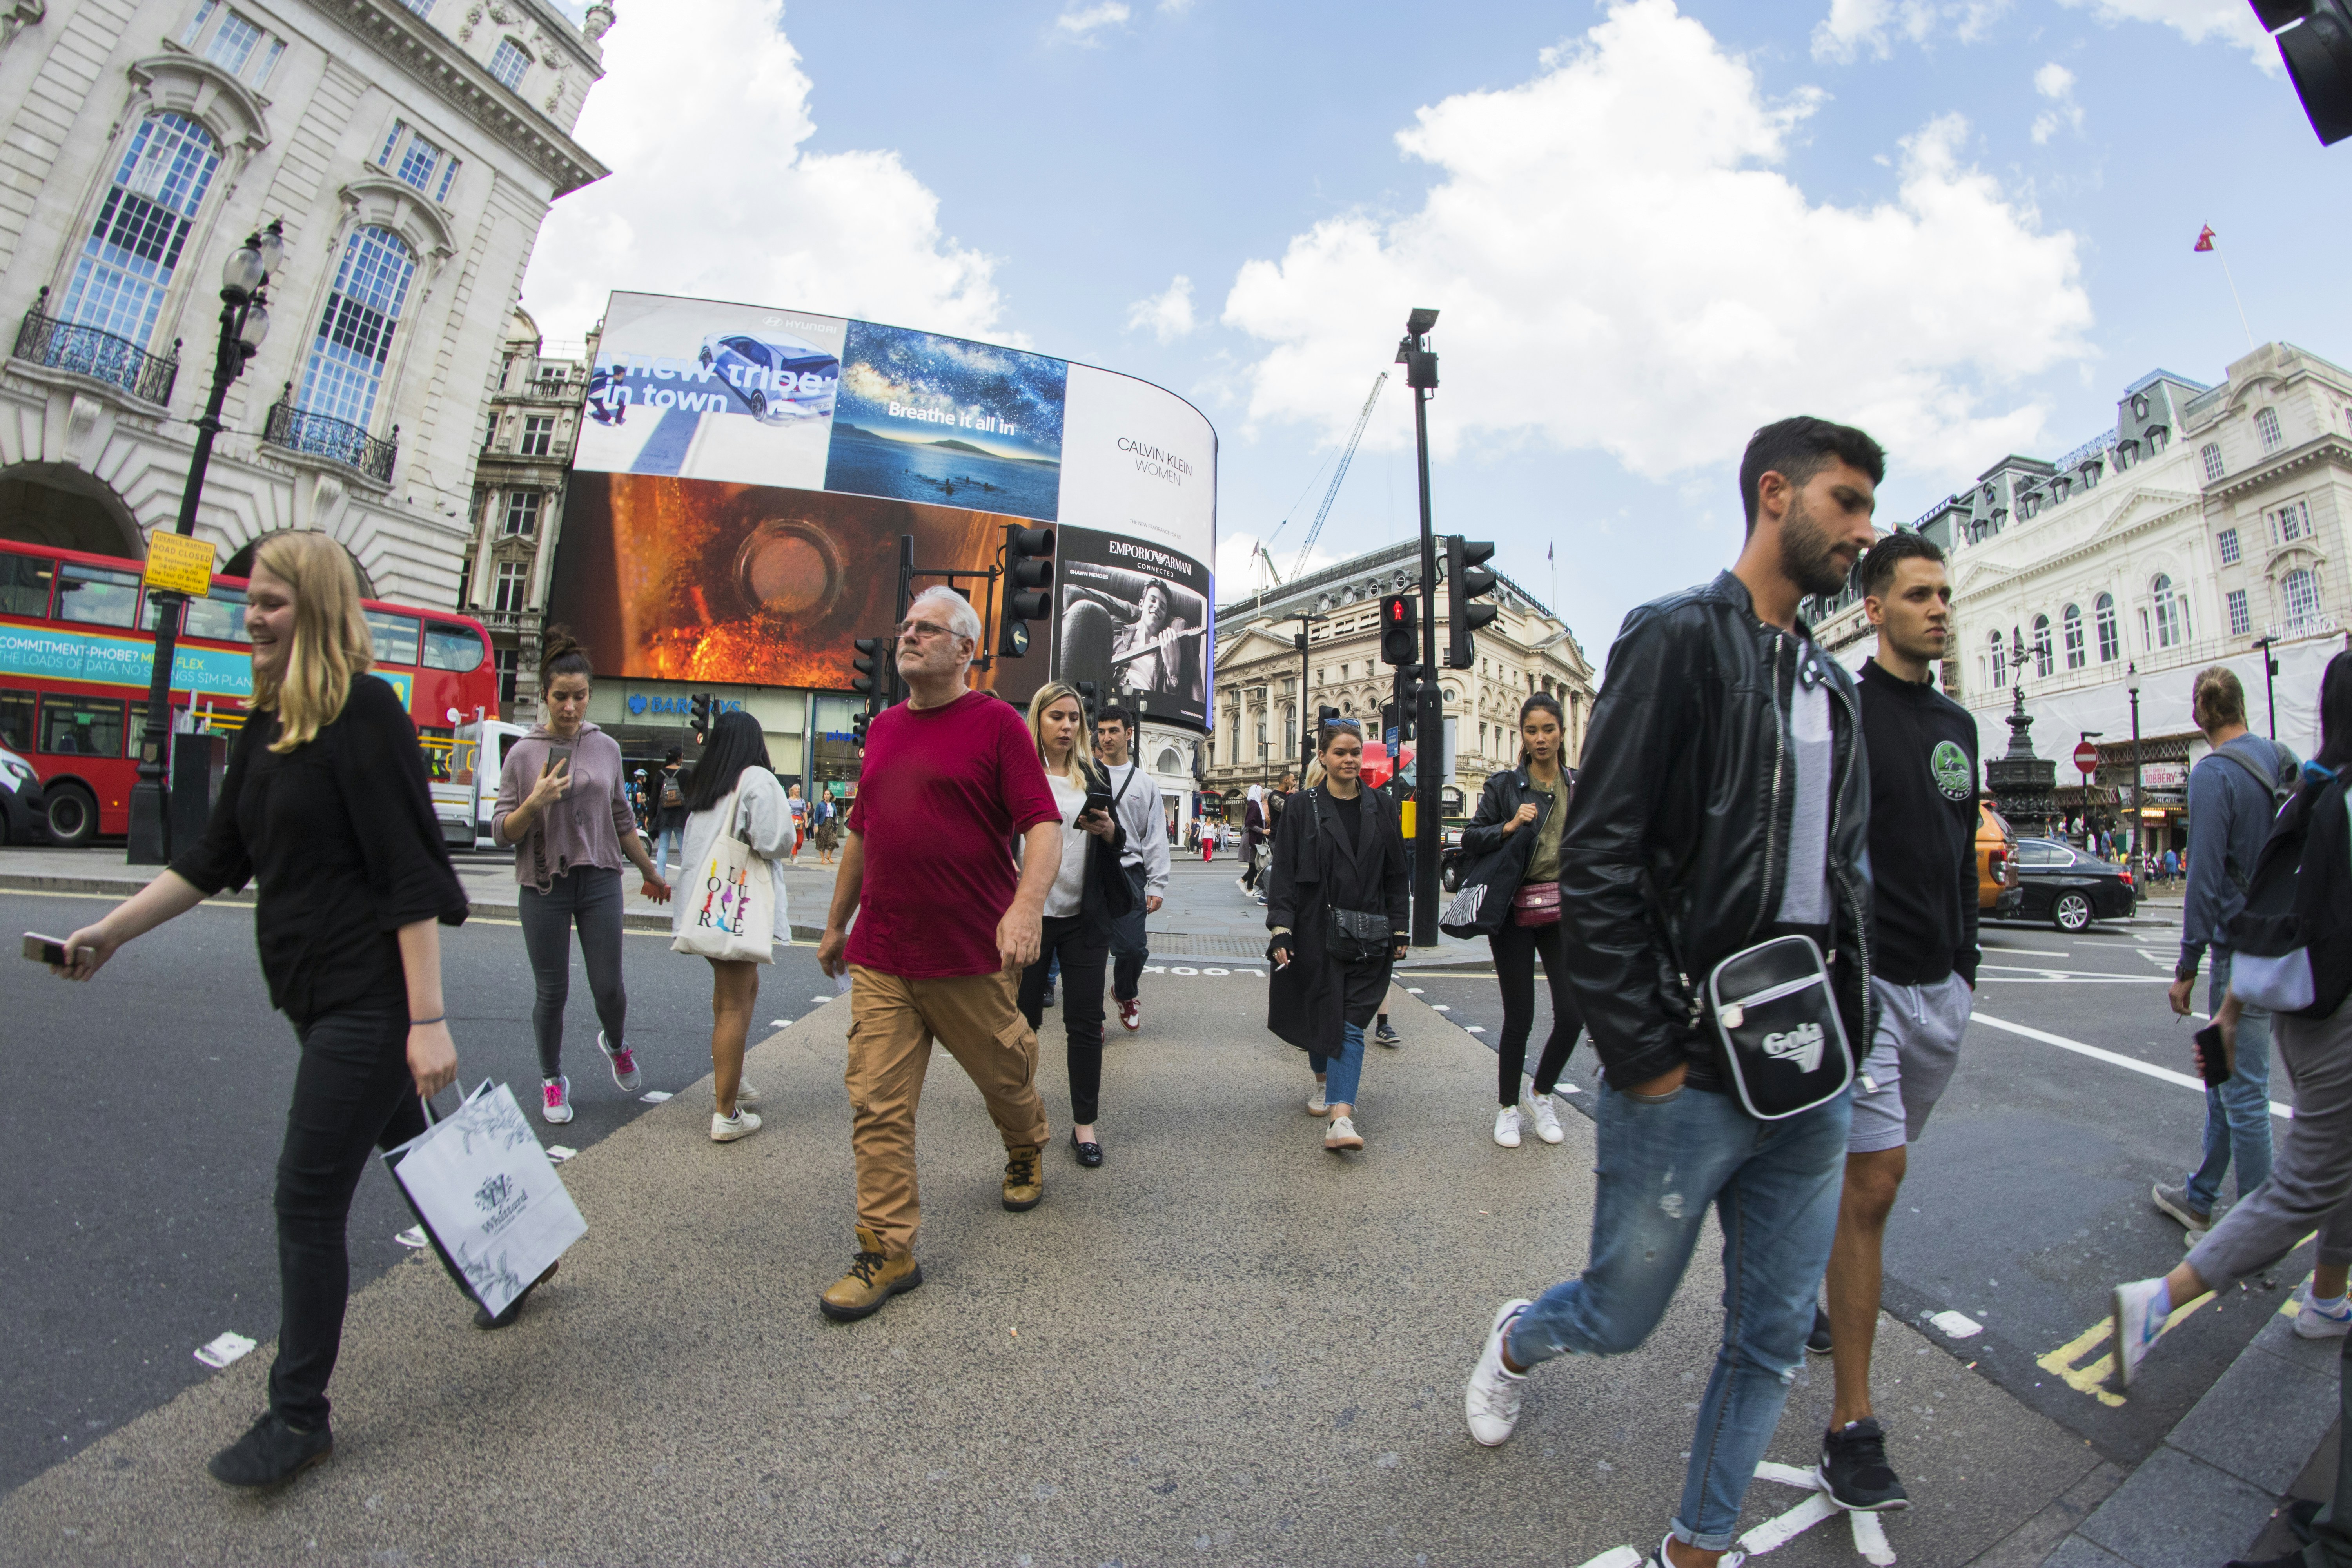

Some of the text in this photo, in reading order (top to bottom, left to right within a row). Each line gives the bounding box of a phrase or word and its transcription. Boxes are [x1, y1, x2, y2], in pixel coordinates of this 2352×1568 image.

[786, 319, 837, 334] HYUNDAI
[625, 352, 717, 383] new
[602, 377, 728, 414] in town
[889, 401, 1014, 436] Breathe it all in
[1118, 437, 1192, 477] CALVIN KLEIN
[1135, 458, 1180, 486] WOMEN
[1148, 524, 1170, 535] FRAGRANCE
[153, 543, 211, 562] ROAD CLOSED
[155, 534, 212, 553] ADVANCE WARNING
[164, 556, 193, 567] September
[1109, 541, 1191, 576] EMPORIO ARMANI
[1089, 572, 1109, 580] MENDES
[1137, 563, 1174, 577] CONNECTED
[23, 652, 64, 667] LOADS
[67, 657, 83, 670] OF
[122, 663, 141, 677] NO
[198, 673, 218, 685] SIM
[2145, 772, 2176, 784] ROBBERY
